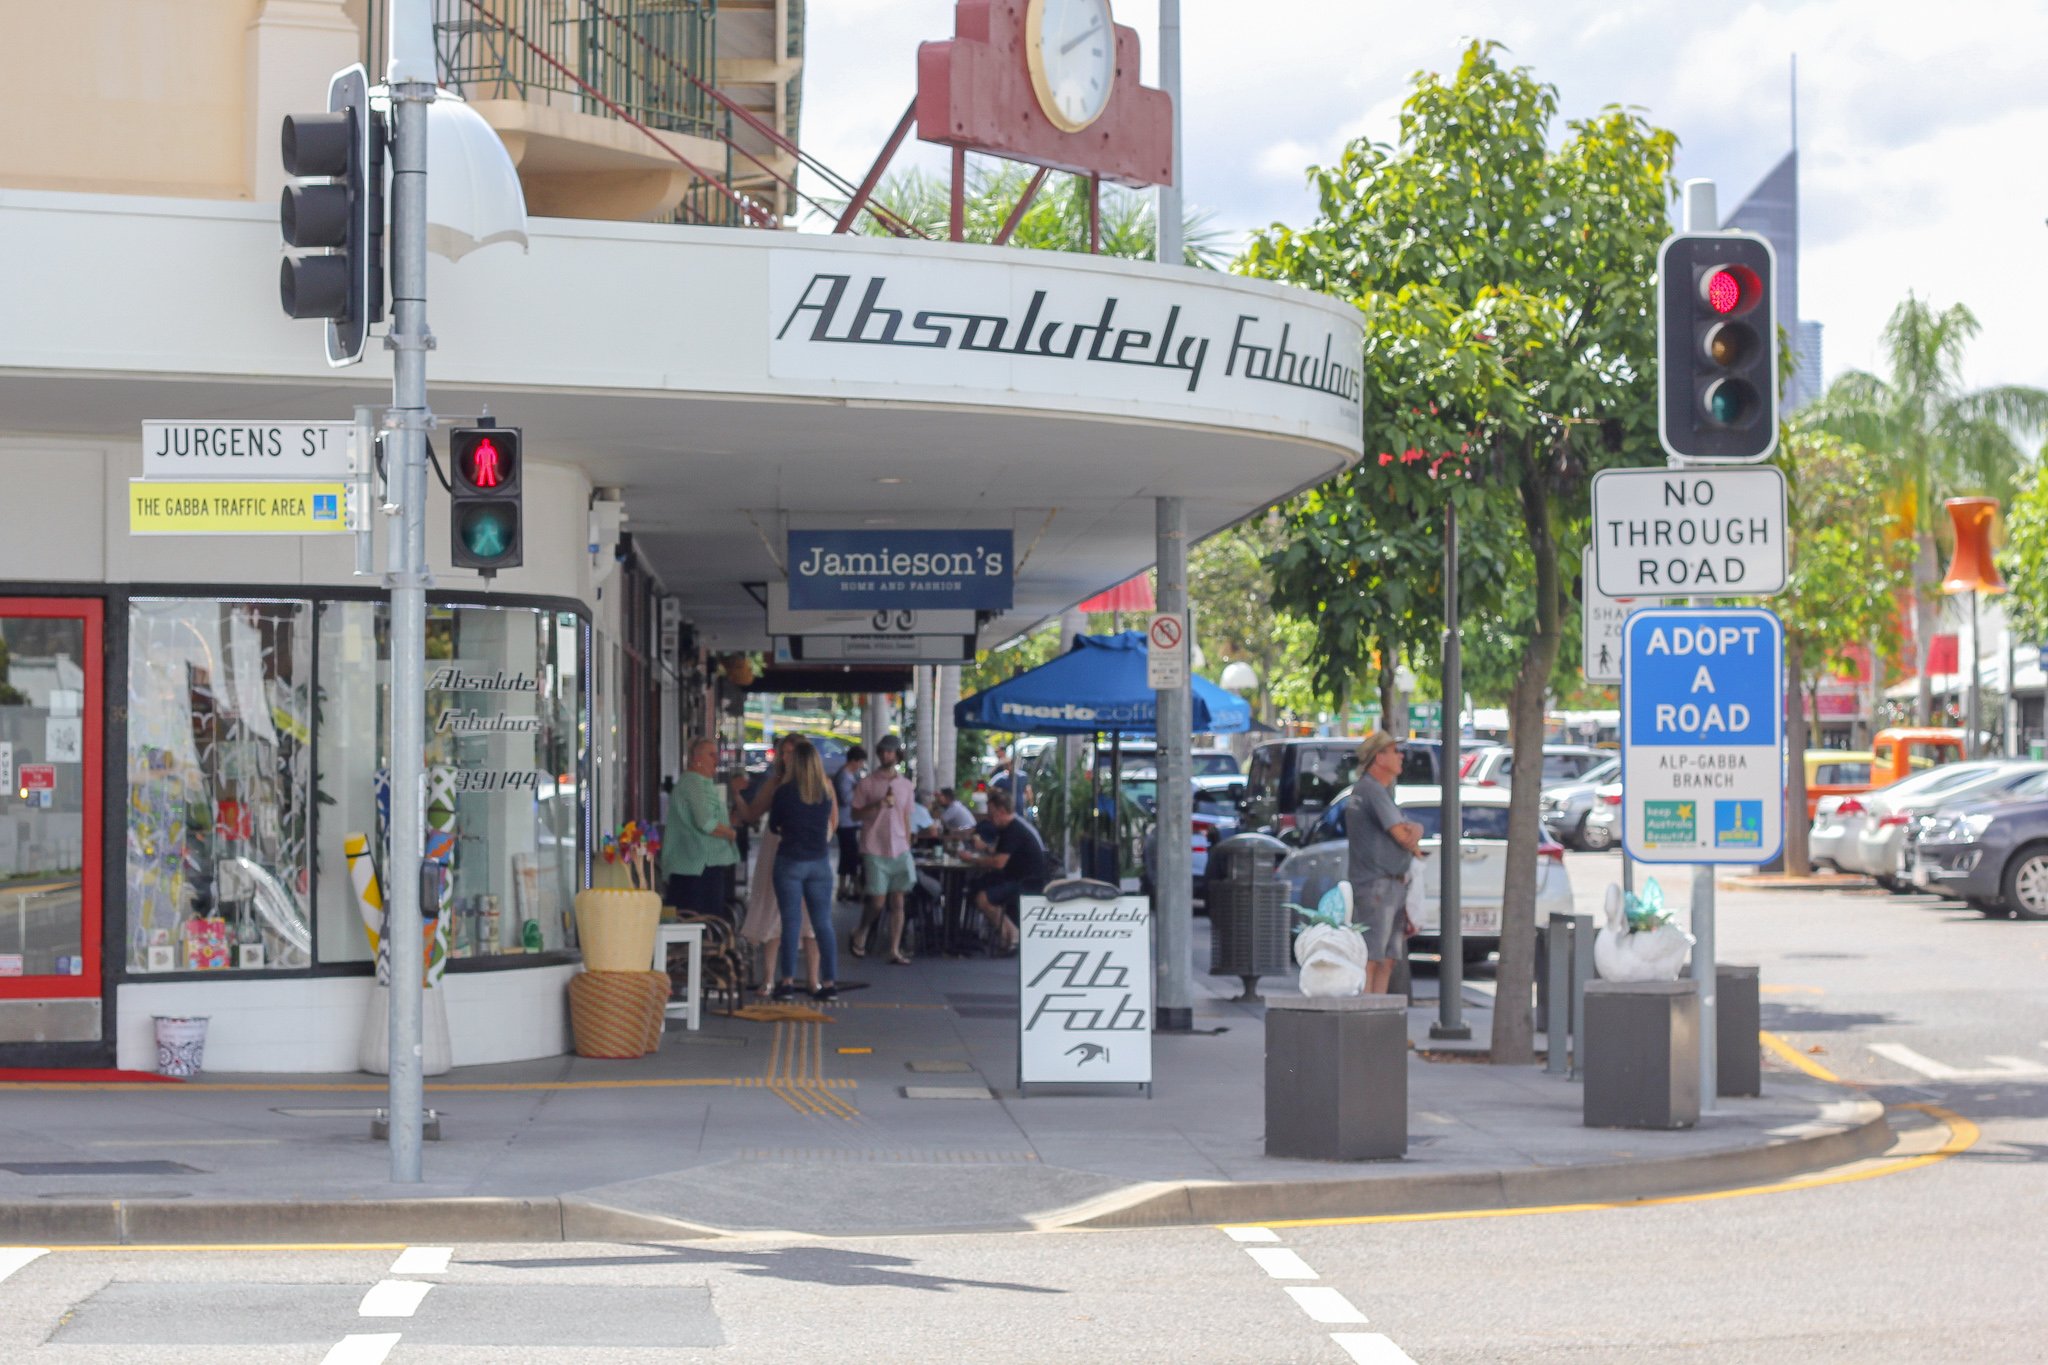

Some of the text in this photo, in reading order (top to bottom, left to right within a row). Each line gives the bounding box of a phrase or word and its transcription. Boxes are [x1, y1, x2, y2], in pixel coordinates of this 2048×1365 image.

[775, 273, 1360, 405] Absolutely Fabulous
[156, 427, 329, 457] JURGENS ST
[136, 497, 161, 516] THE
[165, 497, 210, 516] GABBA
[214, 497, 267, 516] TRAFFIC
[271, 497, 307, 516] AREA
[1664, 479, 1714, 507] NO
[1607, 517, 1769, 547] THROUGH
[799, 546, 1004, 576] Jamieson's
[1639, 557, 1746, 586] ROAD
[840, 581, 962, 591] HOME AND FASHION
[1645, 626, 1760, 656] ADOPT
[1690, 665, 1716, 694] A
[1655, 703, 1751, 733] ROAD
[1659, 754, 1748, 769] ALP-GABBA
[1672, 773, 1735, 789] BRANCH
[1022, 905, 1150, 927] Absolutely
[1026, 922, 1134, 940] Fabulous
[1026, 950, 1131, 989] Ab
[1024, 993, 1147, 1032] Fab
